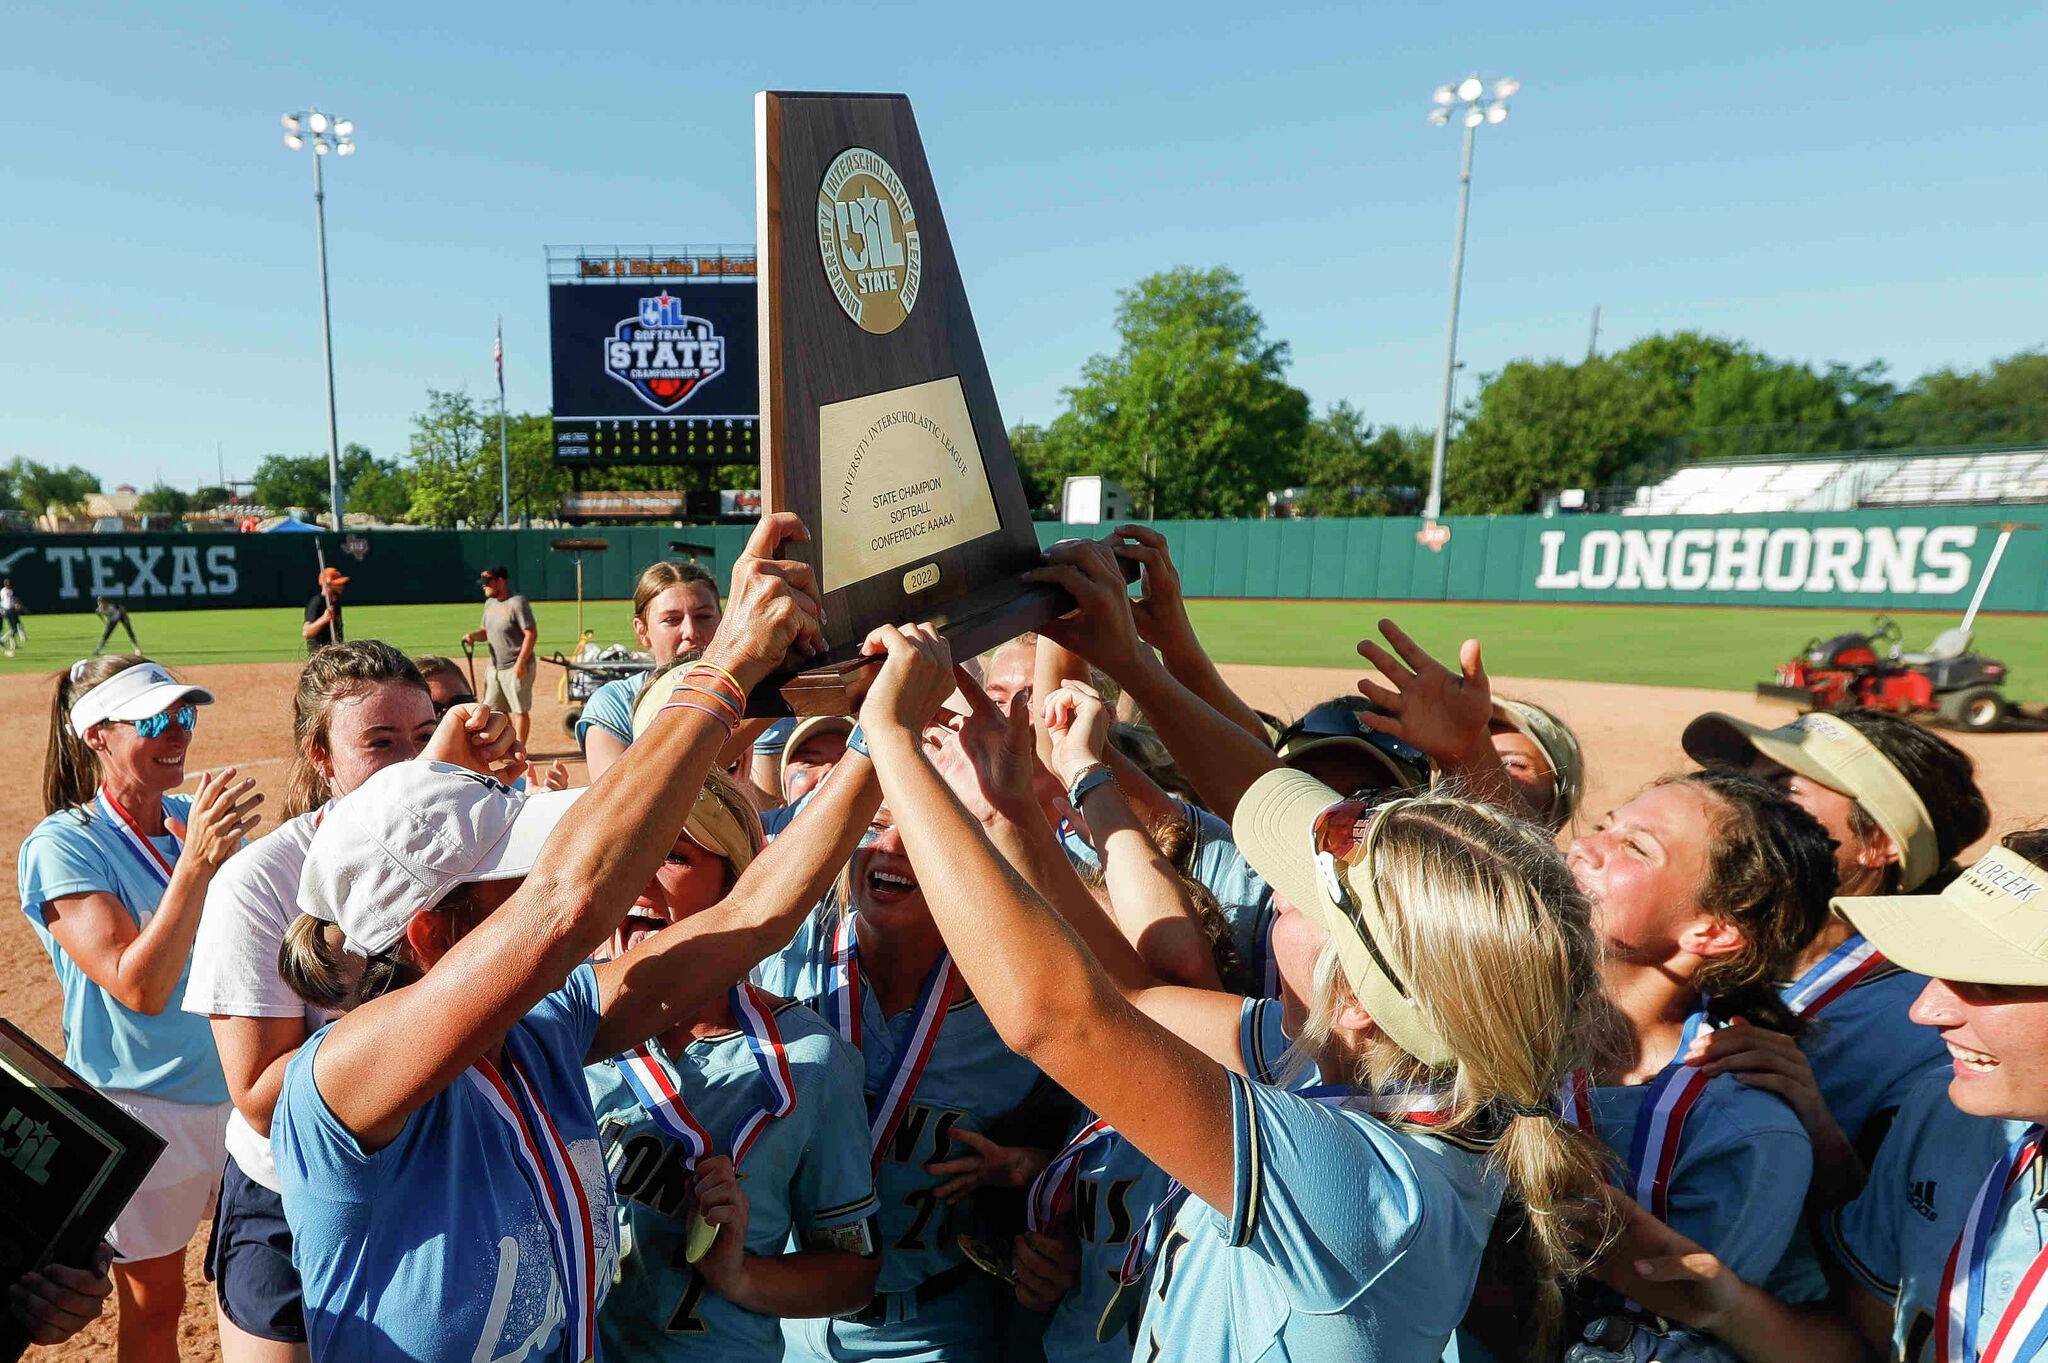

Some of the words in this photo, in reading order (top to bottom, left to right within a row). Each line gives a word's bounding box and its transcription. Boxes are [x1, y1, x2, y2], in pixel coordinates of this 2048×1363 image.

[827, 153, 911, 220] INTERSCHOLASTIC
[820, 208, 860, 318] UNIVERSITY
[903, 237, 919, 305] LEAGUE
[857, 269, 898, 294] STATE
[639, 297, 687, 329] UIL
[633, 329, 694, 340] SOFTBALL
[609, 341, 719, 368] STATE
[841, 434, 869, 514] UNIVERSITY
[868, 410, 941, 440] INTERSCHOLASTIC
[940, 433, 968, 477] LEAGUE
[872, 491, 897, 509] STATE
[898, 478, 942, 501] CHAMPION
[890, 501, 931, 524] SOFTBALL
[871, 522, 926, 551] CONFERENCE
[927, 513, 955, 532] AAAAA
[45, 546, 238, 598] TEXAS
[1536, 525, 1978, 594] LONGHORNS
[911, 570, 933, 588] 2022
